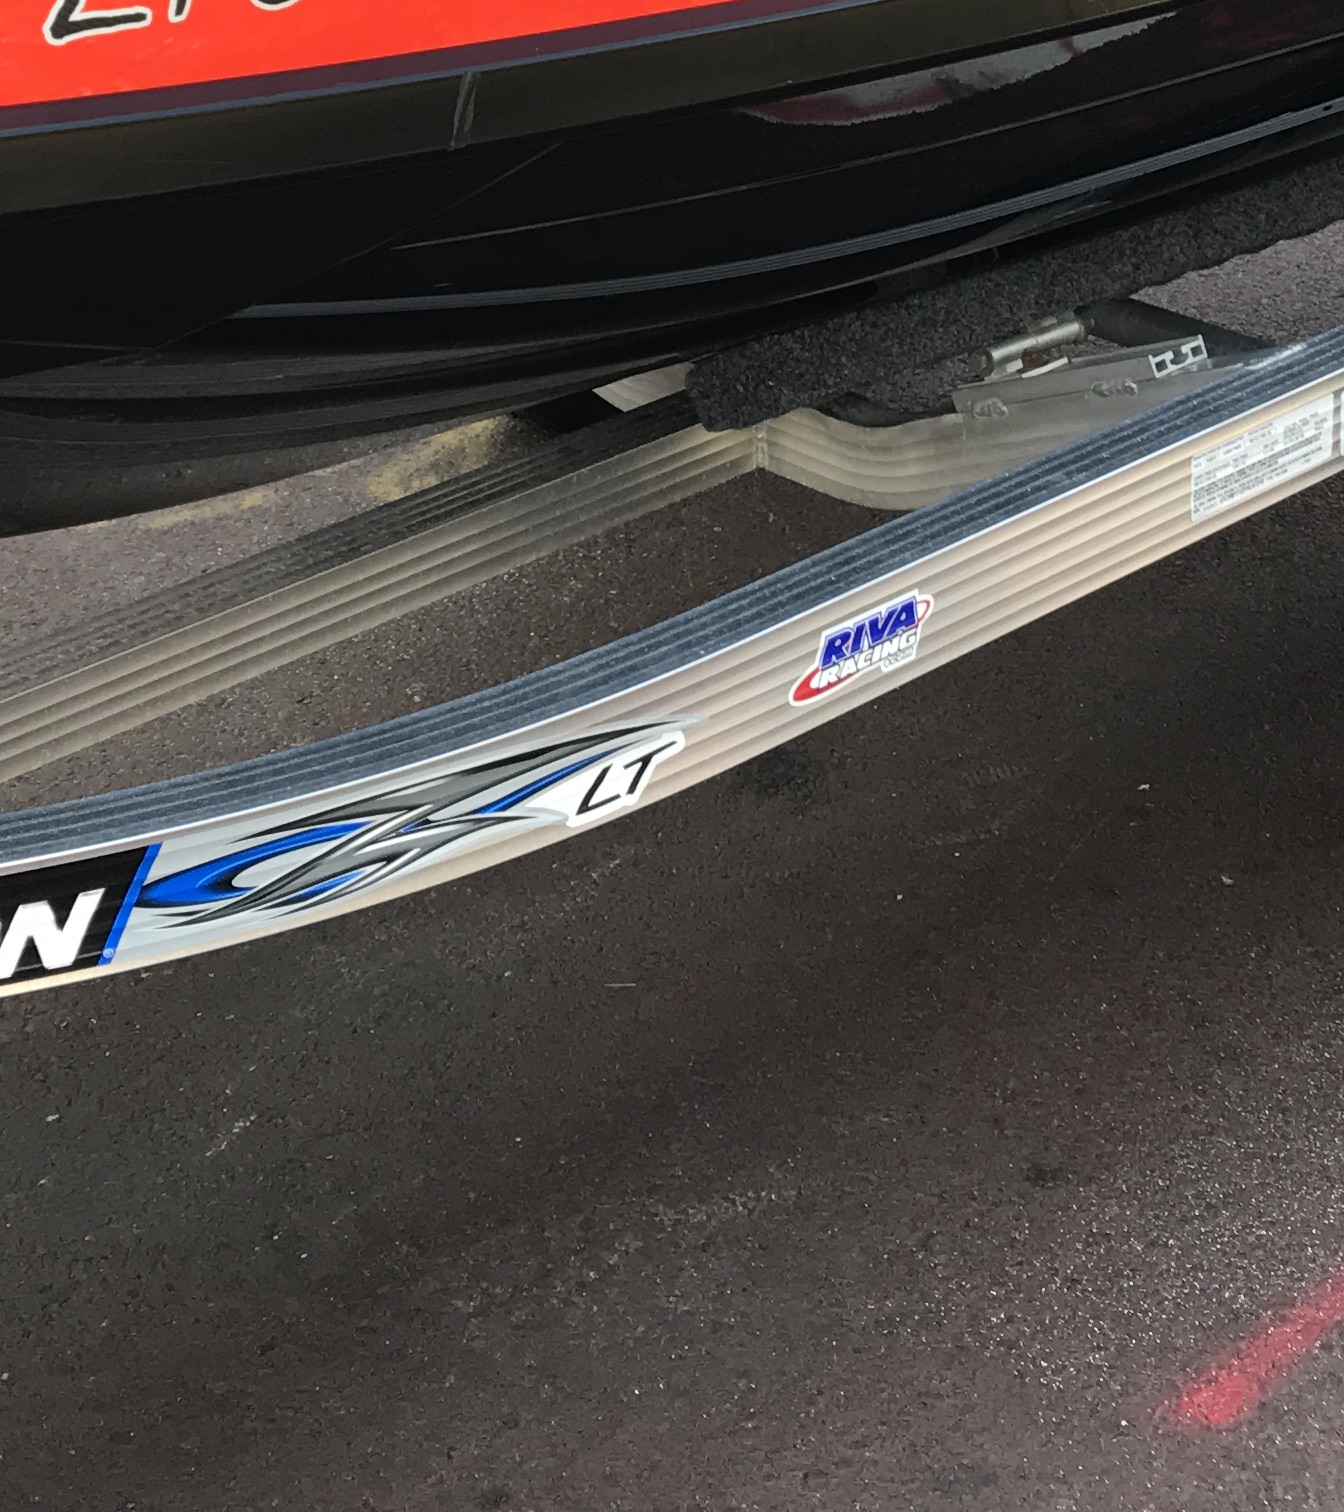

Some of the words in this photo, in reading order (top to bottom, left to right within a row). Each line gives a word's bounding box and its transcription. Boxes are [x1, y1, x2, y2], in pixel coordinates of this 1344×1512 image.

[818, 629, 918, 688] RACING
[819, 597, 919, 669] RIVA
[573, 742, 662, 815] LT
